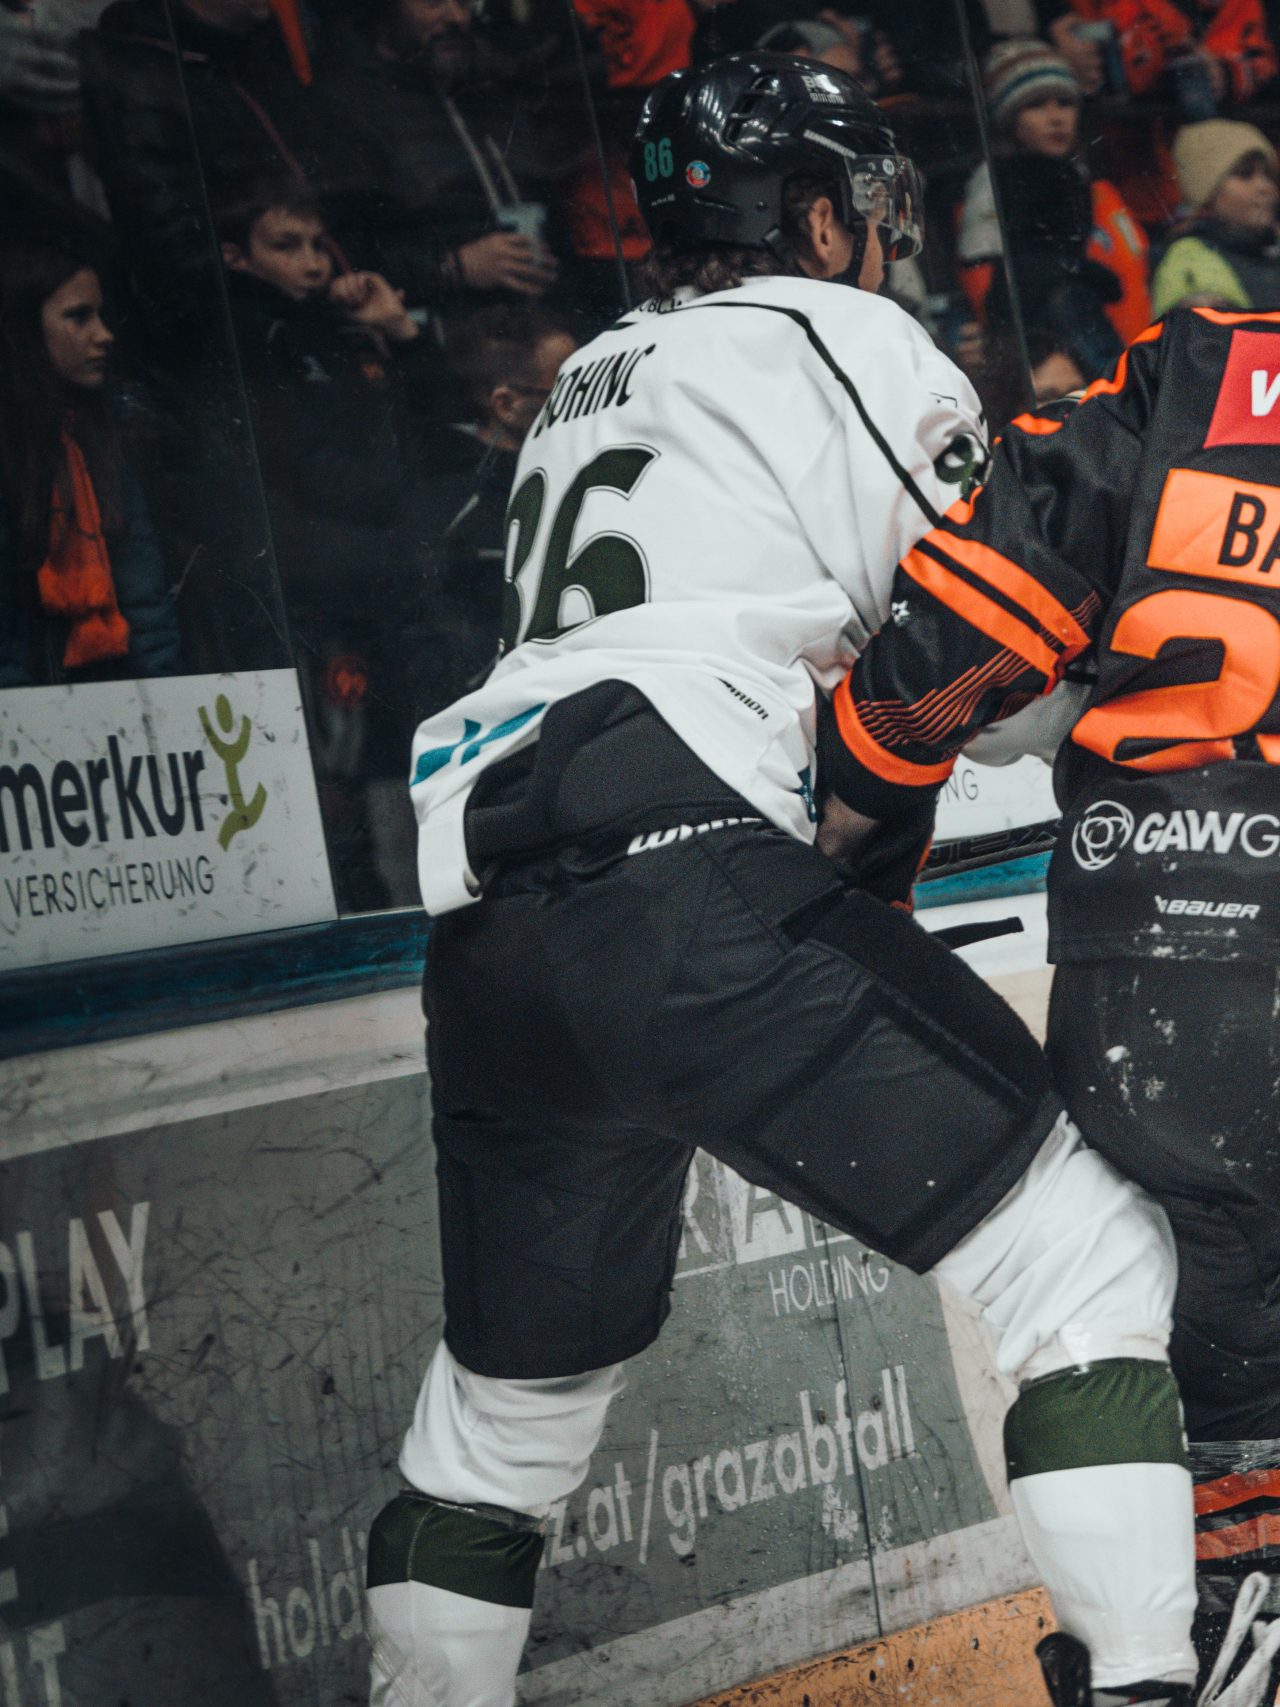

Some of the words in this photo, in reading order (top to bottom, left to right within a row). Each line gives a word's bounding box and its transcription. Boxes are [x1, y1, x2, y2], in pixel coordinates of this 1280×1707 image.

[644, 138, 674, 182] 86
[0, 735, 205, 852] merkur
[5, 855, 215, 917] VERSICHERUNG
[768, 1251, 890, 1316] HOLDING
